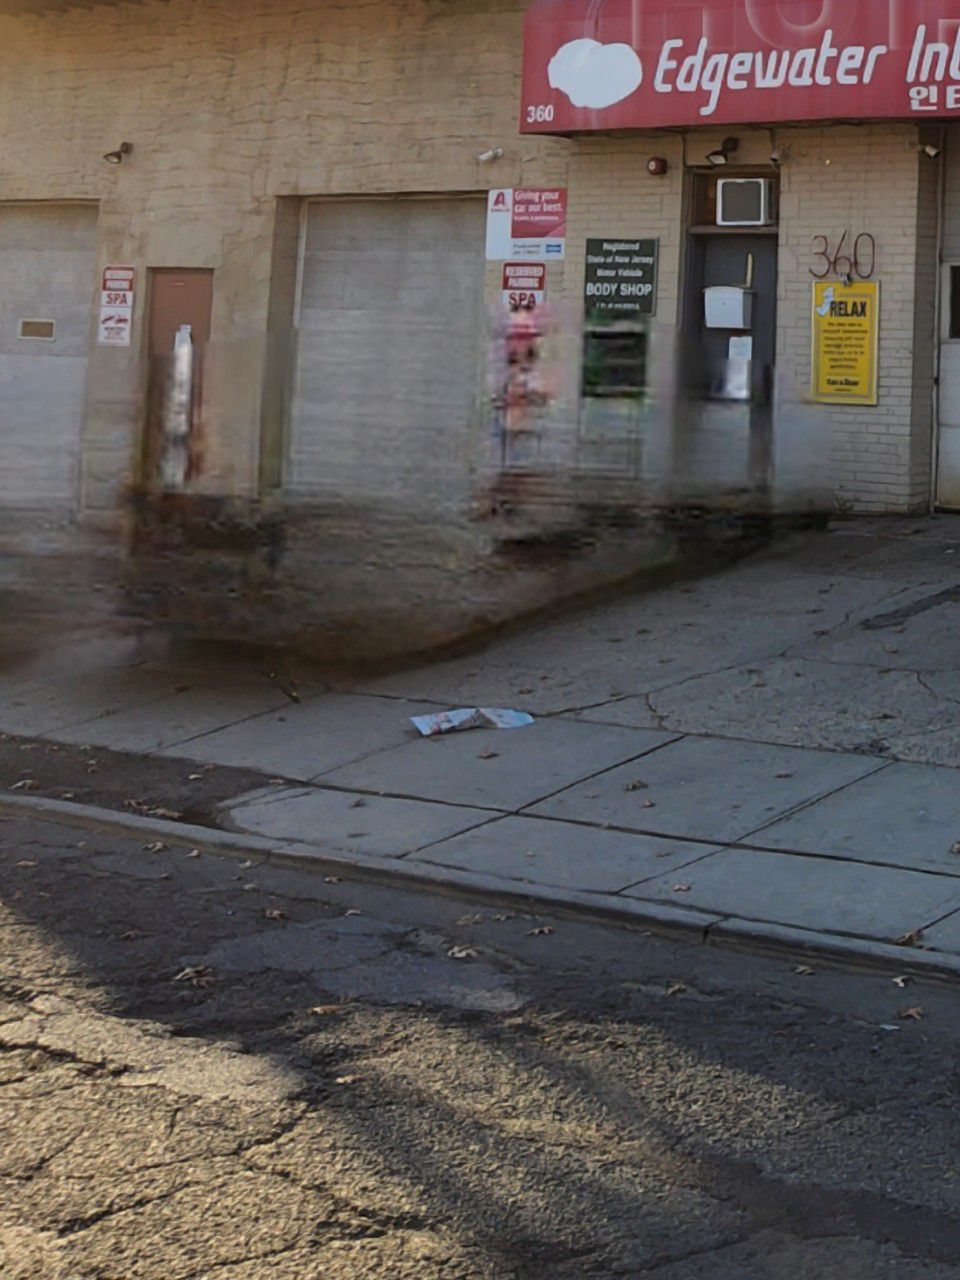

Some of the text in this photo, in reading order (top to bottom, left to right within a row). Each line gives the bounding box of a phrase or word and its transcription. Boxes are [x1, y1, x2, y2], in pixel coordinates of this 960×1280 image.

[653, 29, 888, 116] Edgewater
[526, 105, 554, 123] 360
[808, 229, 876, 279] 360
[586, 282, 652, 296] BODY SHOP
[105, 292, 128, 305] SPA
[829, 300, 868, 318] RELAX
